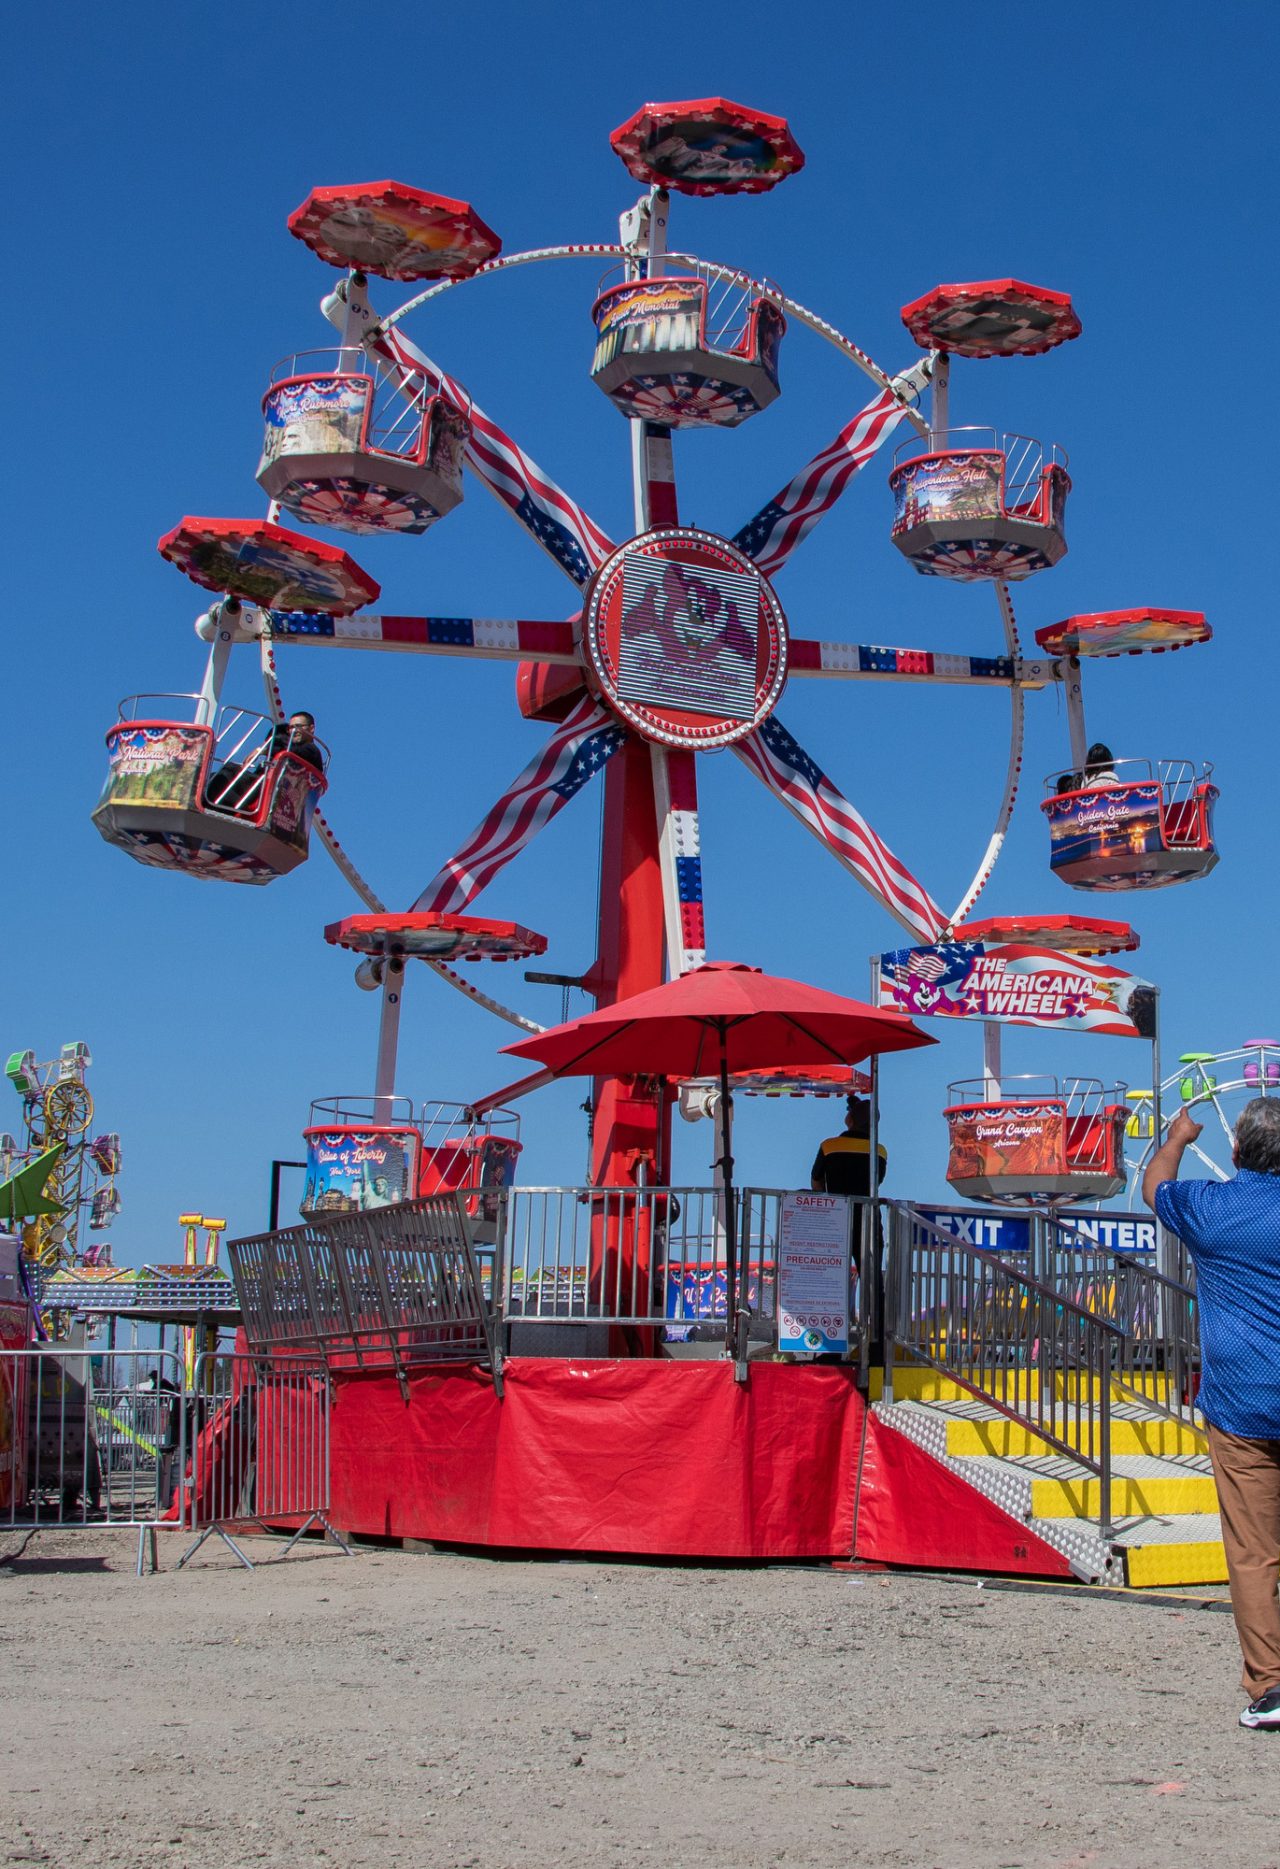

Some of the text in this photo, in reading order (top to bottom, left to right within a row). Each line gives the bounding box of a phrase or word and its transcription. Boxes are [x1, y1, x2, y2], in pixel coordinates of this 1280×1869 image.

[961, 468, 987, 482] Hall
[122, 746, 200, 762] National Park
[1077, 804, 1130, 827] Golden Gate
[1088, 823, 1120, 833] California
[973, 957, 1007, 973] THE
[964, 972, 1094, 997] AMERICANA
[987, 991, 1067, 1015] WHEEL
[976, 1122, 1043, 1141] Grand Canyon
[993, 1140, 1020, 1148] Arizona
[340, 1149, 350, 1161] of
[351, 1148, 387, 1165] Liberty
[329, 1166, 344, 1177] New
[795, 1196, 836, 1207] SAFETY
[934, 1216, 1003, 1246] EXIT
[1062, 1218, 1156, 1250] ENTER
